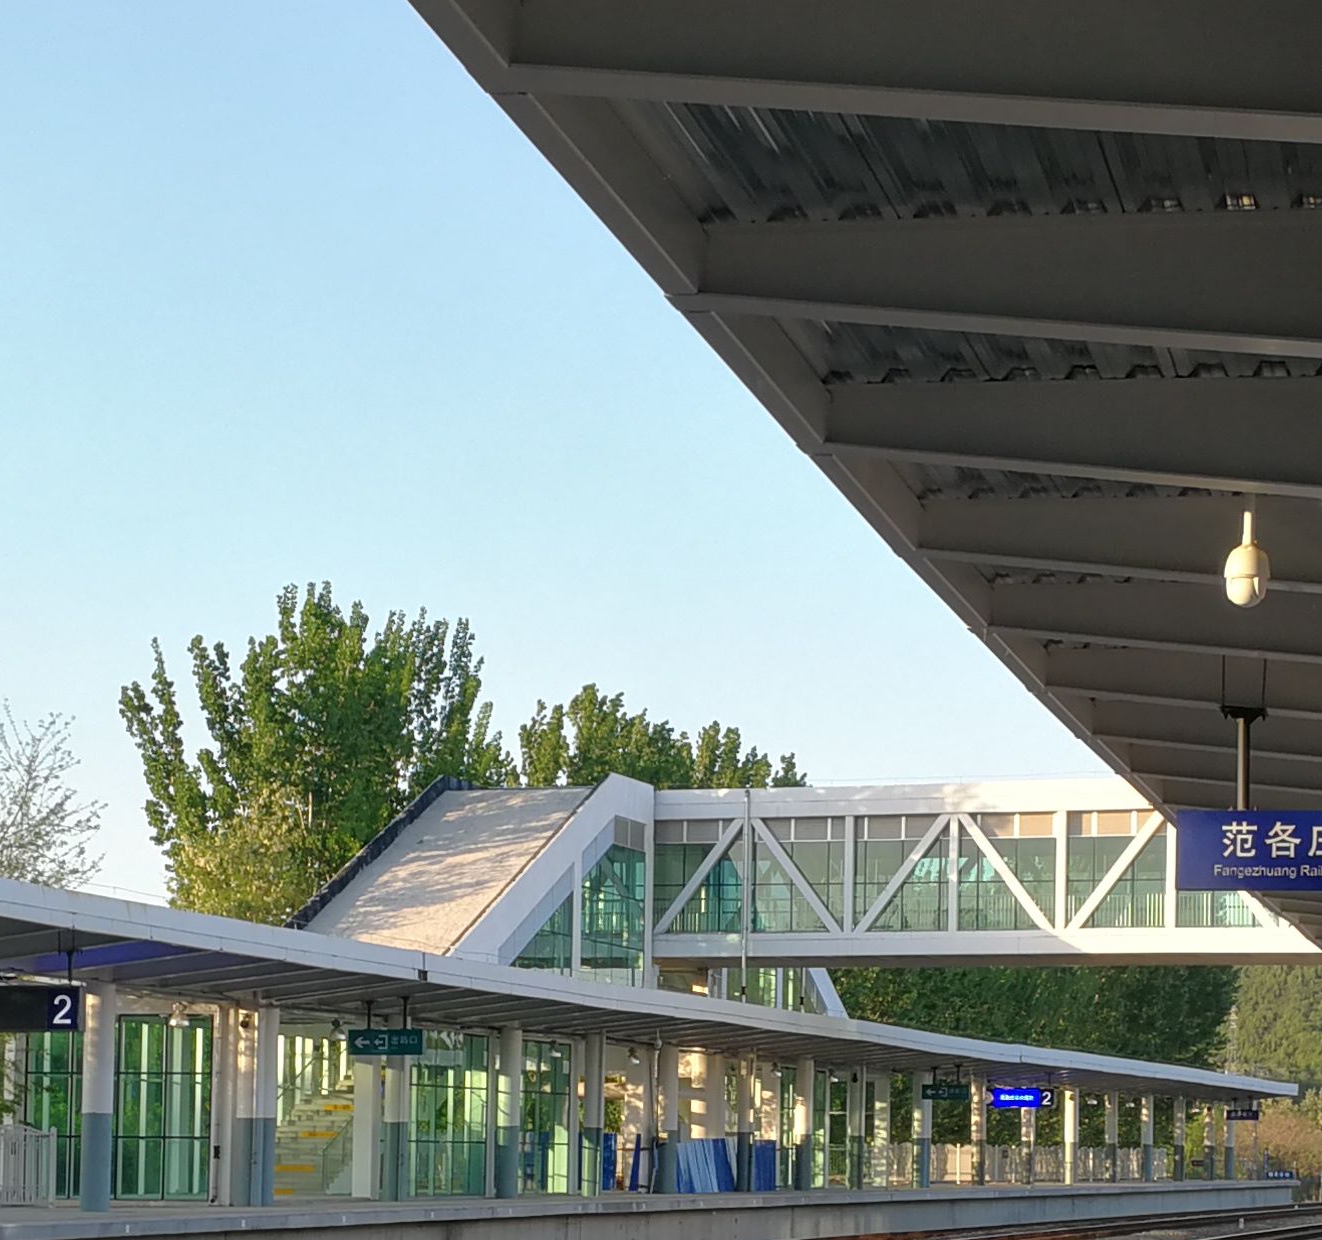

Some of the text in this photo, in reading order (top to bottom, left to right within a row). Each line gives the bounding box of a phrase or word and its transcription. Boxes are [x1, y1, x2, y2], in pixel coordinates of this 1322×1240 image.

[1213, 864, 1297, 879] Fangezhuang
[52, 994, 72, 1025] 2
[1041, 1091, 1052, 1105] 2
